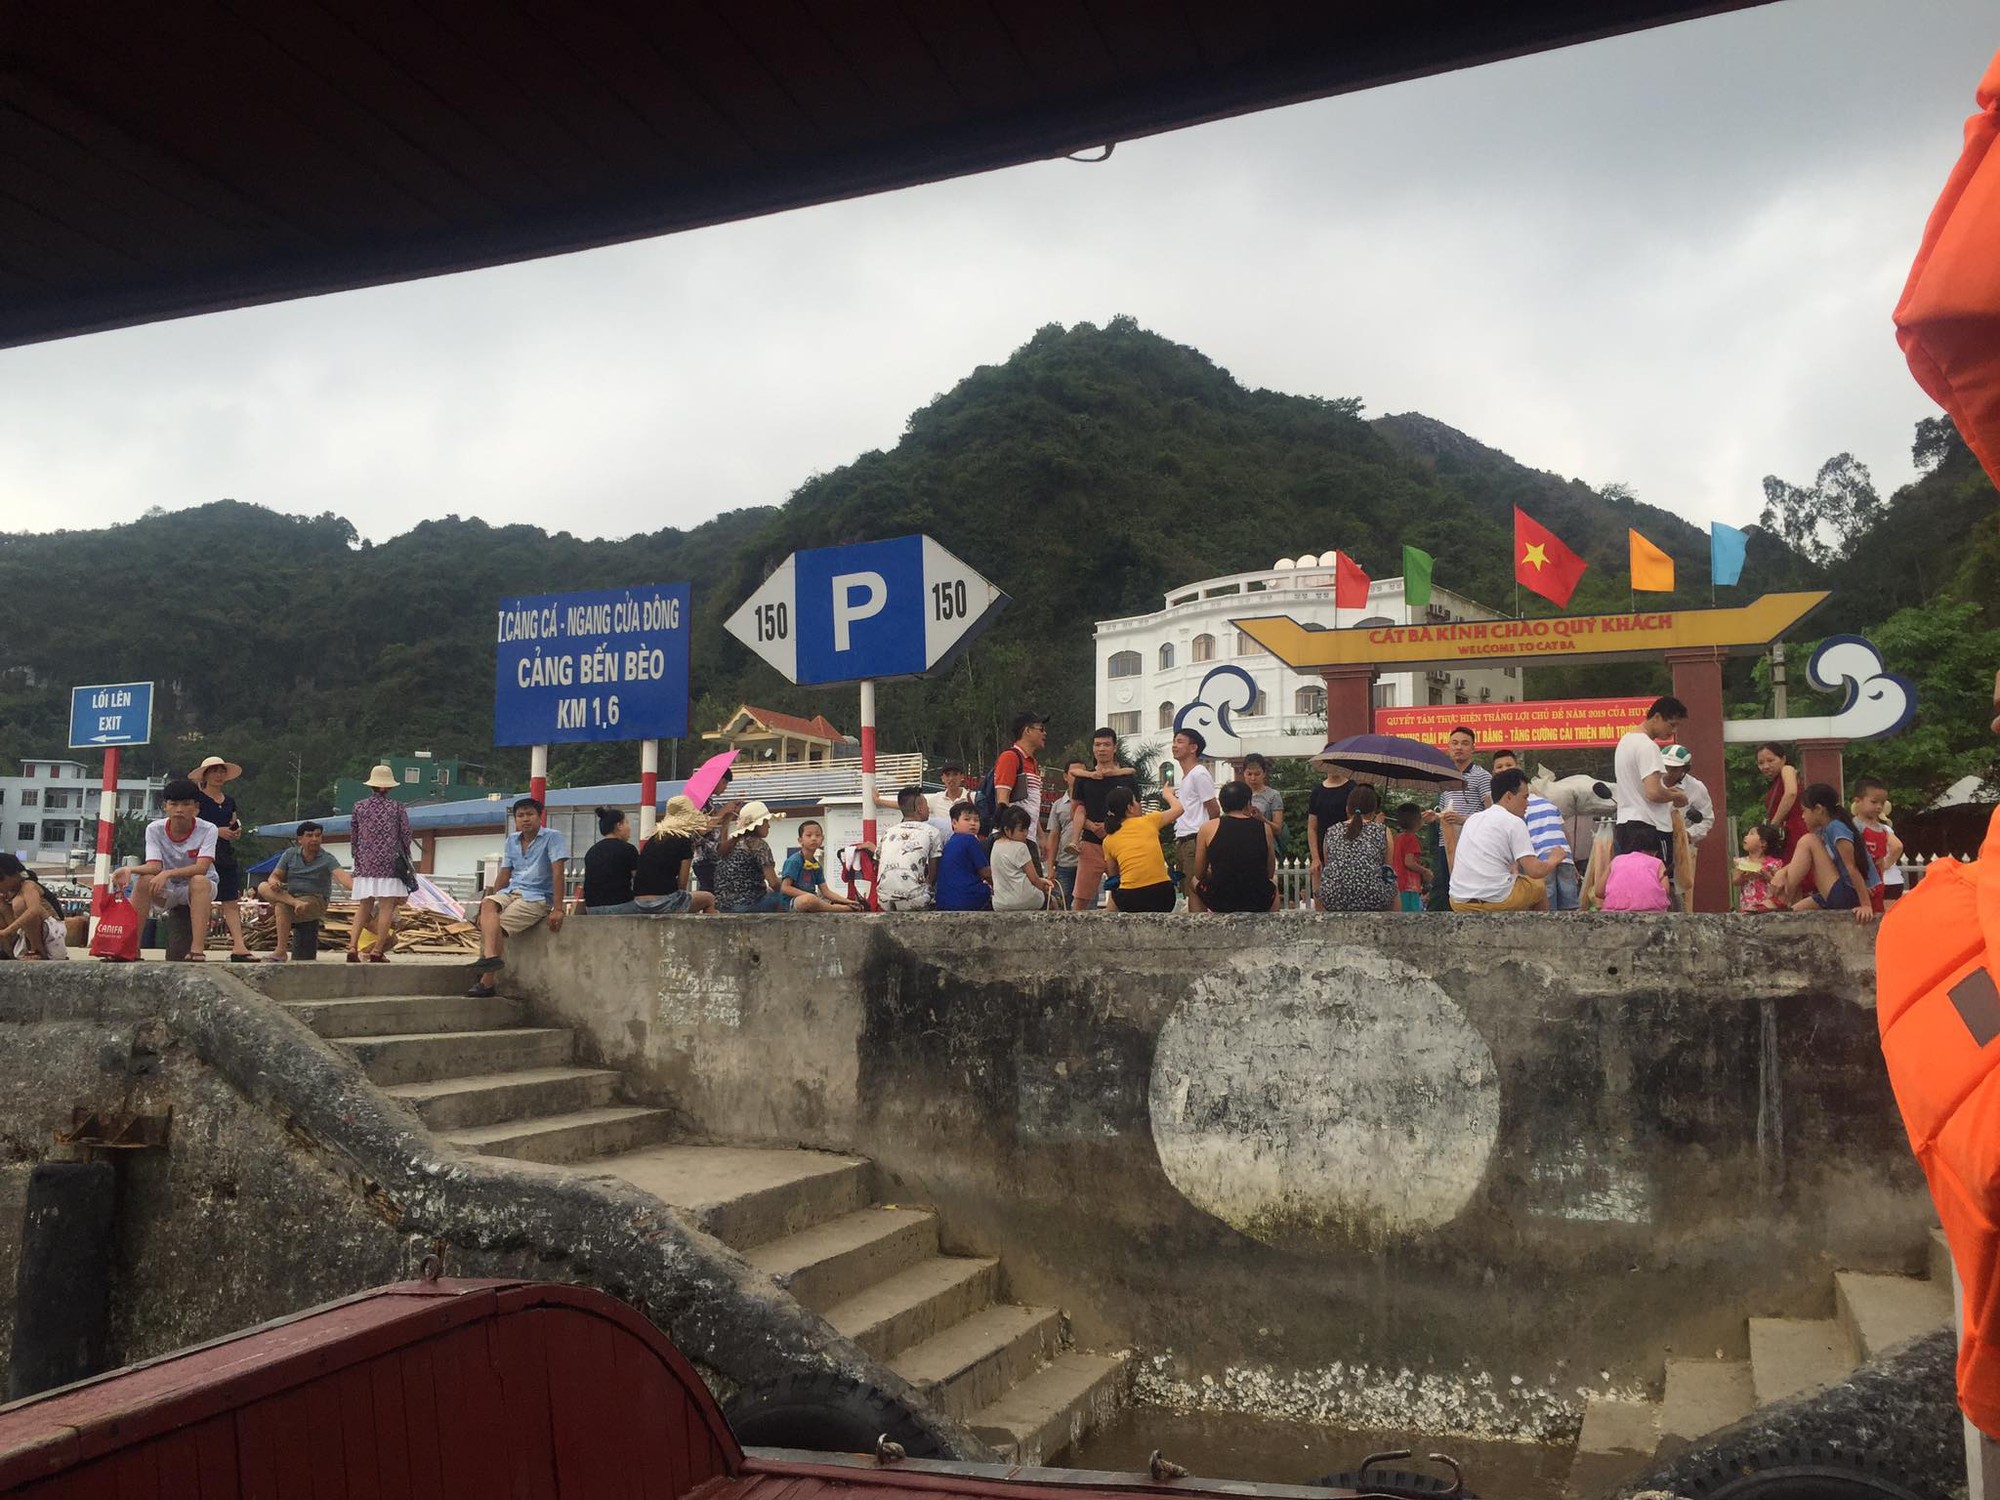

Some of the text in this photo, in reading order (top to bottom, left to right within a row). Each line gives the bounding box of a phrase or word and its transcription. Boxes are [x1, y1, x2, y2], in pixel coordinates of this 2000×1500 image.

[541, 602, 558, 638] CÁ
[567, 604, 611, 637] NGANG
[614, 590, 640, 634] CỬA
[643, 594, 680, 631] ĐÔNG
[754, 571, 967, 652] 150 P 150
[1407, 626, 1433, 643] BÀ
[1436, 622, 1487, 641] KÍNH
[1490, 619, 1549, 639] CHÀO
[1553, 617, 1597, 637] QUÝ
[1602, 613, 1673, 633] KHÁCH
[1457, 643, 1516, 655] WELCOME
[1518, 642, 1534, 651] TO
[517, 642, 665, 688] CẢNG BẾN BÈO
[92, 688, 131, 709] LỐI LÊN
[557, 698, 587, 729] KM
[98, 715, 122, 731] EXIT
[97, 924, 123, 934] CANIFA
